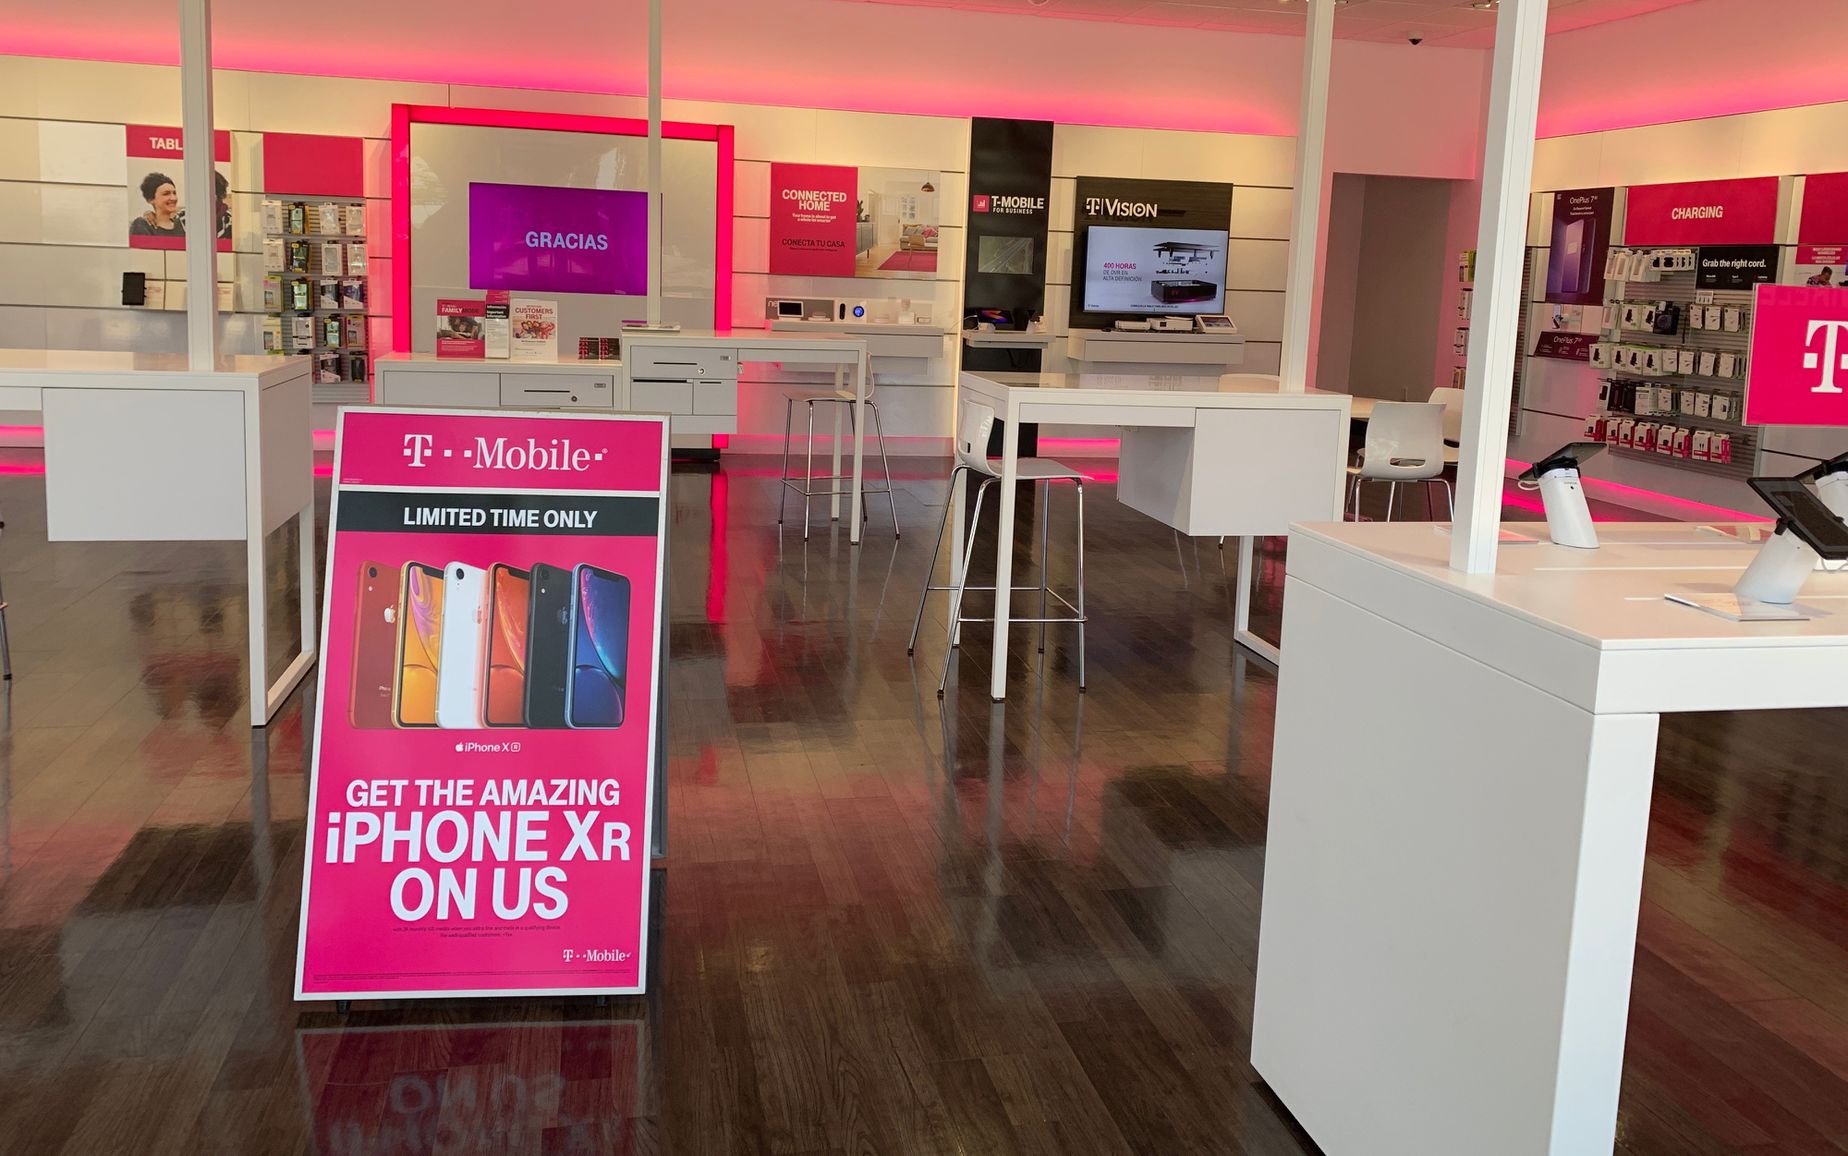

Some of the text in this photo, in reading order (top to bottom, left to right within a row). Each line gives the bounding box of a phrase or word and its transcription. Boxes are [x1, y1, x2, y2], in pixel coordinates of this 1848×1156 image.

[149, 137, 183, 150] TABL
[782, 189, 847, 202] CONNECTED
[991, 195, 1044, 209] T-MOBILE
[799, 200, 830, 211] HOME
[1671, 205, 1723, 219] CHARGING
[525, 231, 608, 250] GRACIAS
[827, 240, 845, 248] CASA
[1702, 259, 1766, 269] Grab the right cord.
[404, 507, 598, 529] LIMITED TIME ONLY
[465, 742, 500, 752] iPhone
[346, 778, 620, 807] GET THE AMAZING
[325, 810, 549, 863] iPHONE
[390, 866, 568, 921] ON US
